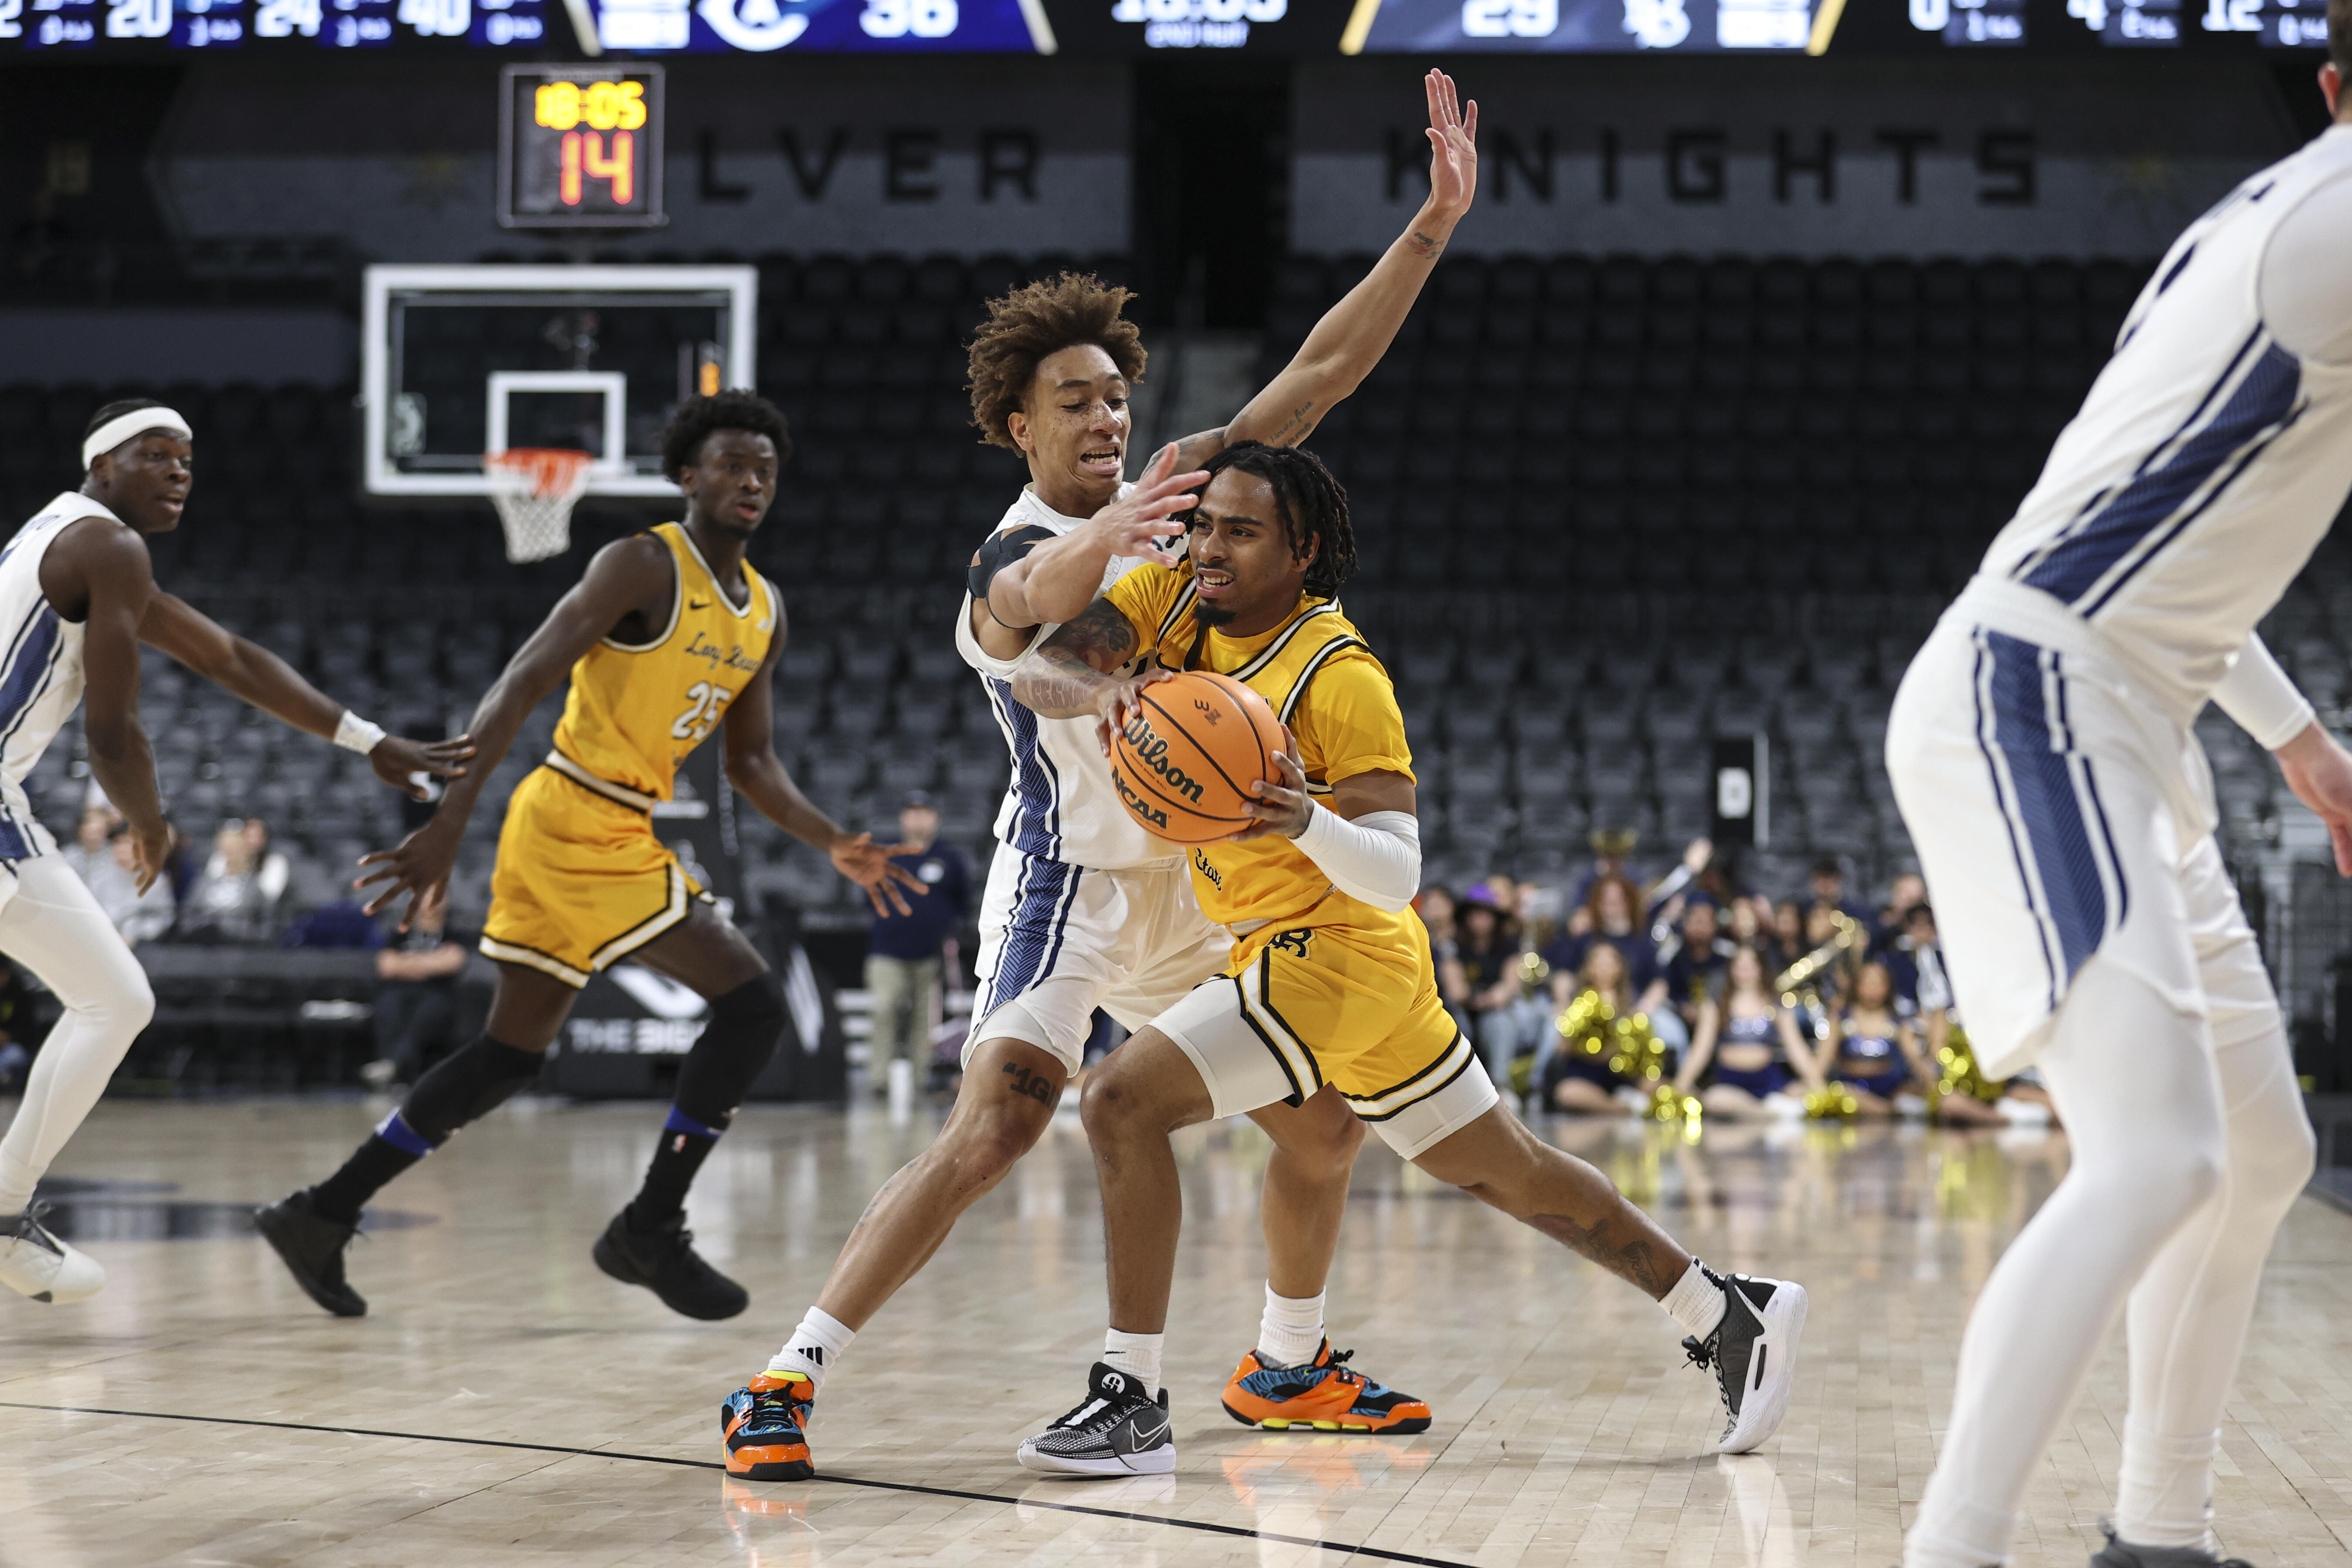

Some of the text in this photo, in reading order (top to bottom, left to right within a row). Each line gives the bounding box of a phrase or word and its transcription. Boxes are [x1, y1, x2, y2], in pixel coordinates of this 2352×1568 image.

[560, 131, 633, 205] 14
[1384, 126, 2040, 206] KNIGHTS
[671, 680, 732, 741] 25
[1124, 715, 1205, 806] Wilson
[1111, 765, 1168, 830] NCAA
[568, 1017, 632, 1054] THE
